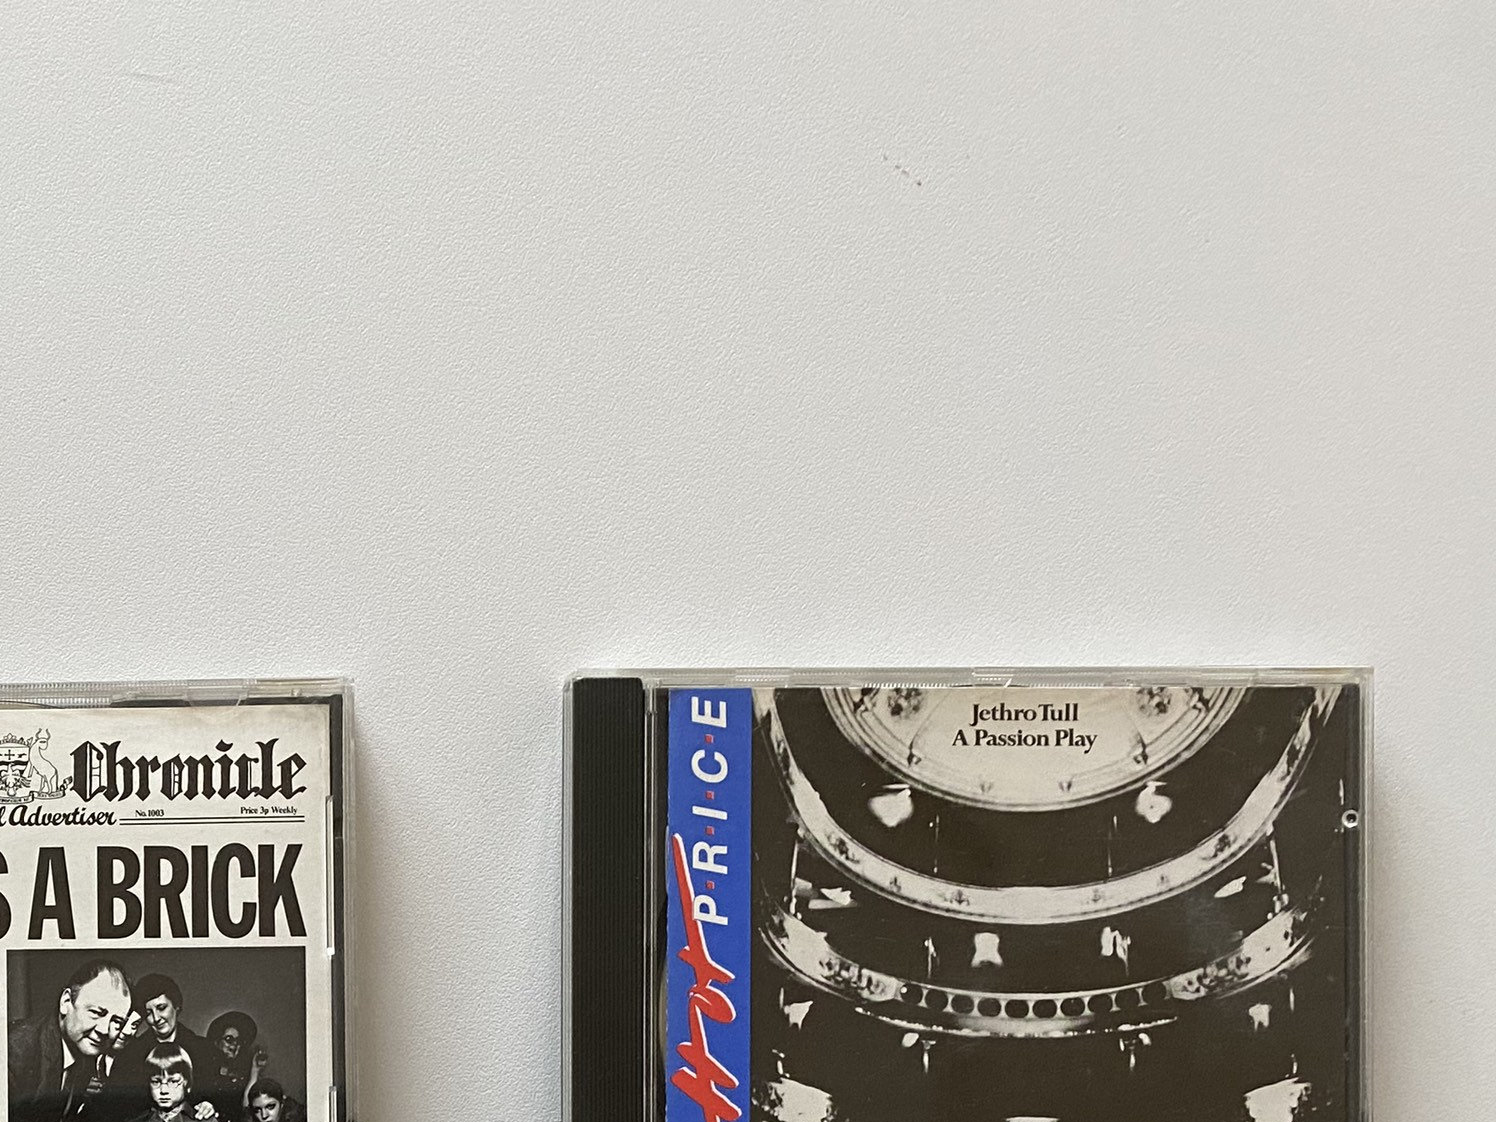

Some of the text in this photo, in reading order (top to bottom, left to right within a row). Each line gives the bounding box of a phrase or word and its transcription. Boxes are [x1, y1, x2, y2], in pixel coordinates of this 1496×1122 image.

[970, 703, 1078, 726] Jethro Tull
[952, 728, 1098, 754] A Passion Play
[70, 738, 307, 802] Chronicle
[9, 805, 117, 826] Advertiser
[241, 806, 297, 816] Price 3p Weekly
[28, 847, 76, 940] A
[97, 843, 307, 939] BRICK
